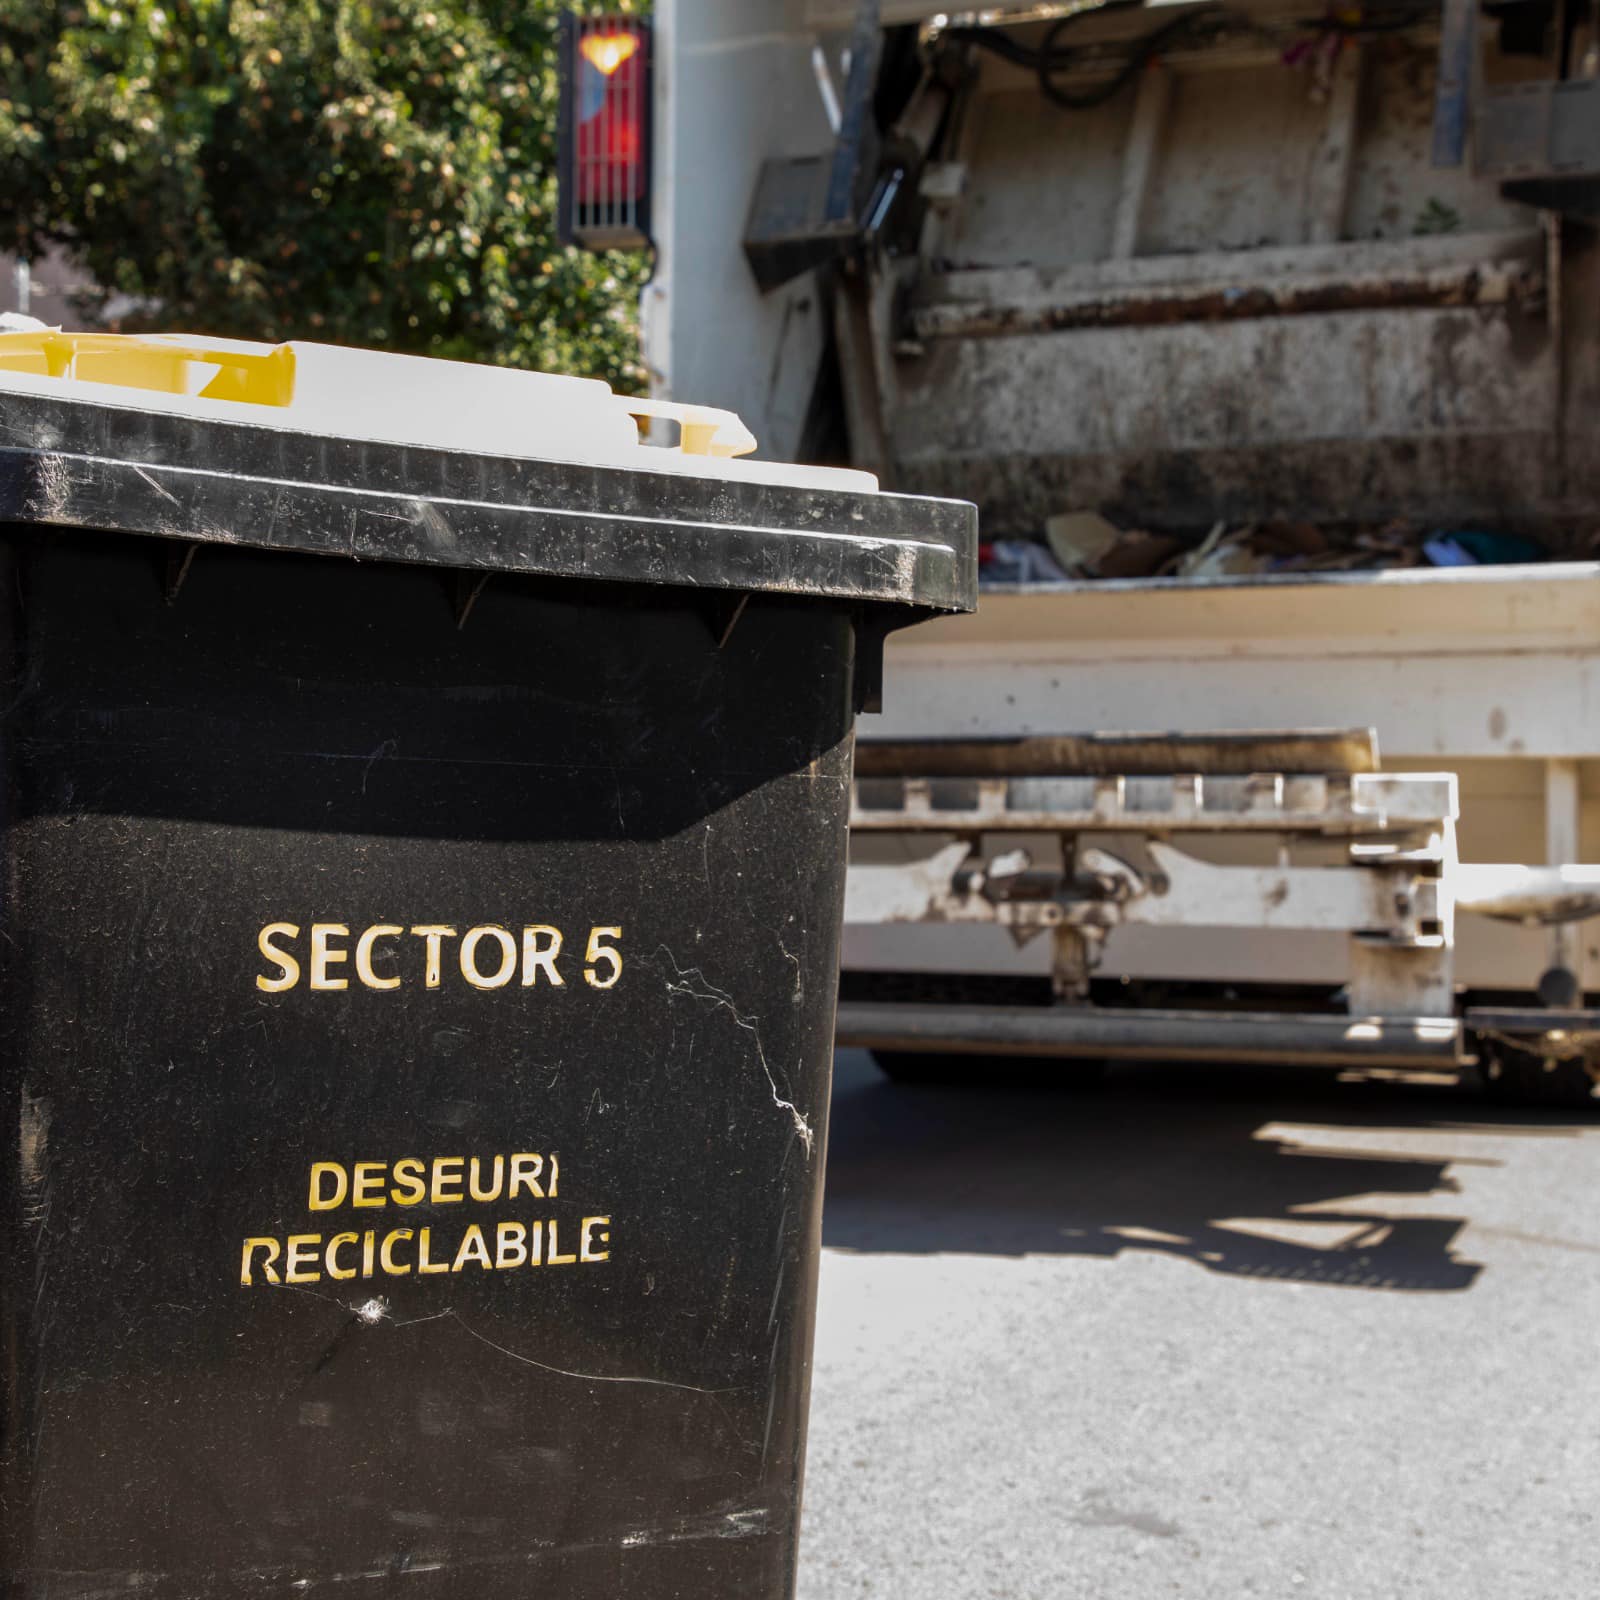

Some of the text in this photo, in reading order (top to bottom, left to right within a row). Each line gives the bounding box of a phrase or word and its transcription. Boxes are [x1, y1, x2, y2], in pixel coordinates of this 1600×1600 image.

[256, 922, 623, 992] SECTOR 5
[308, 1152, 560, 1211] DESEURI
[240, 1215, 611, 1286] RECICLABILE
